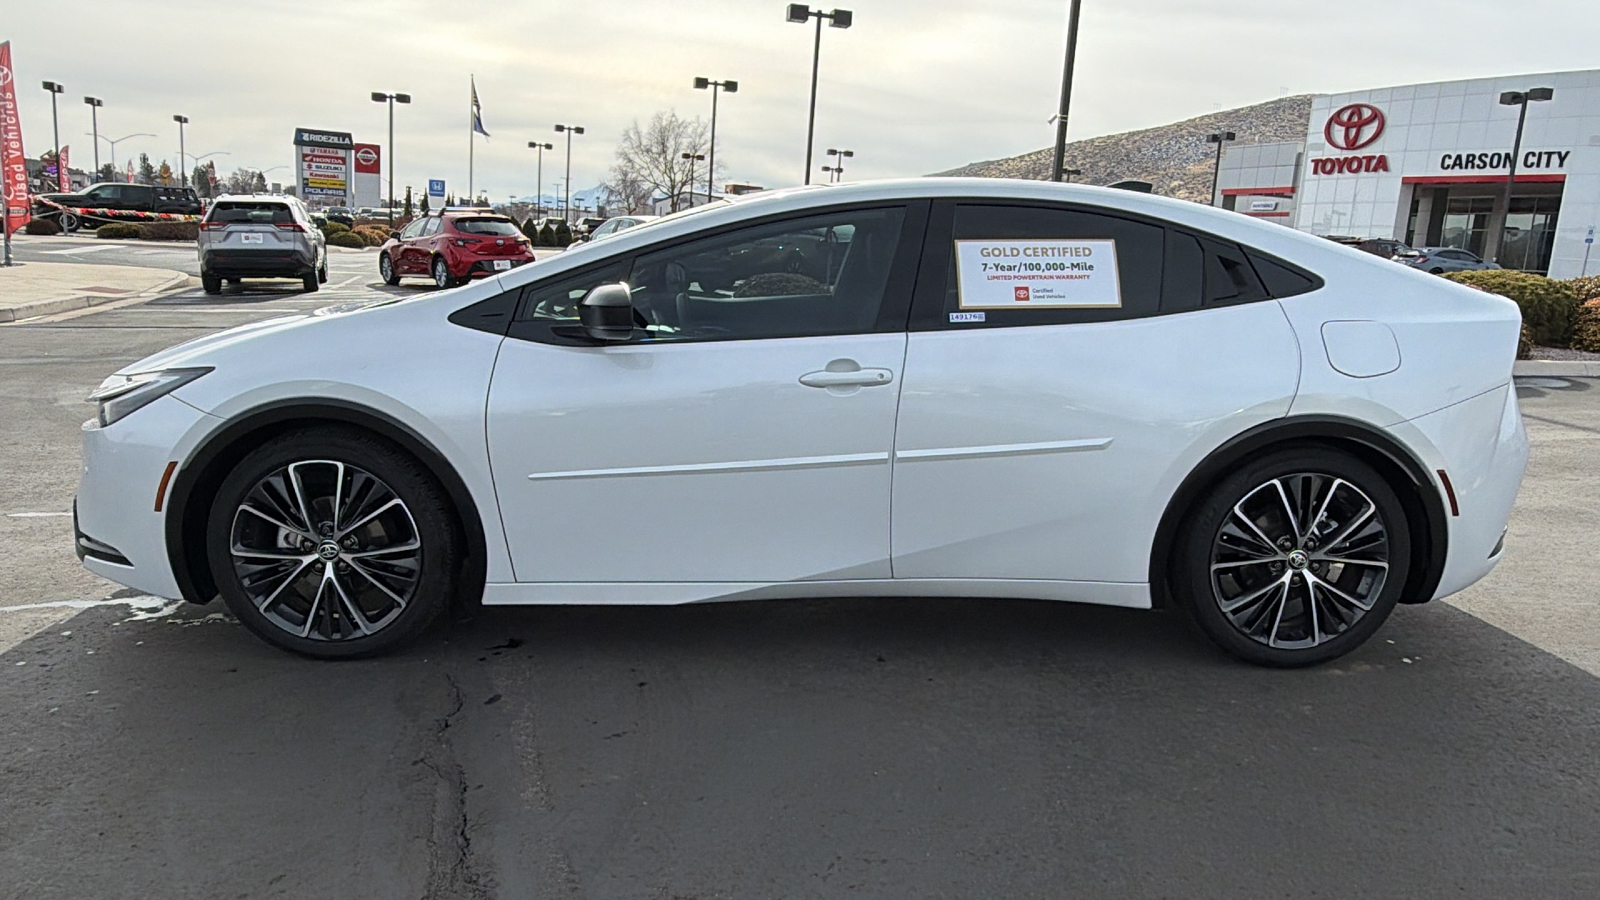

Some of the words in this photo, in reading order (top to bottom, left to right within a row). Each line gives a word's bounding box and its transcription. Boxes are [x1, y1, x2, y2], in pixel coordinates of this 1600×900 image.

[6, 92, 21, 158] Vehicles
[309, 134, 351, 145] RIDEZILLA
[312, 156, 344, 164] HONDA
[1311, 155, 1389, 175] TOYOTA
[1440, 152, 1514, 170] CARSON
[1523, 151, 1571, 168] CITY
[11, 164, 28, 201] Used
[304, 187, 345, 196] POLARIS
[980, 247, 1020, 257] GOLD
[1023, 246, 1093, 257] CERTIFIED
[981, 262, 1095, 273] 7-Year/100,000-Mile
[951, 313, 977, 321] 149176
